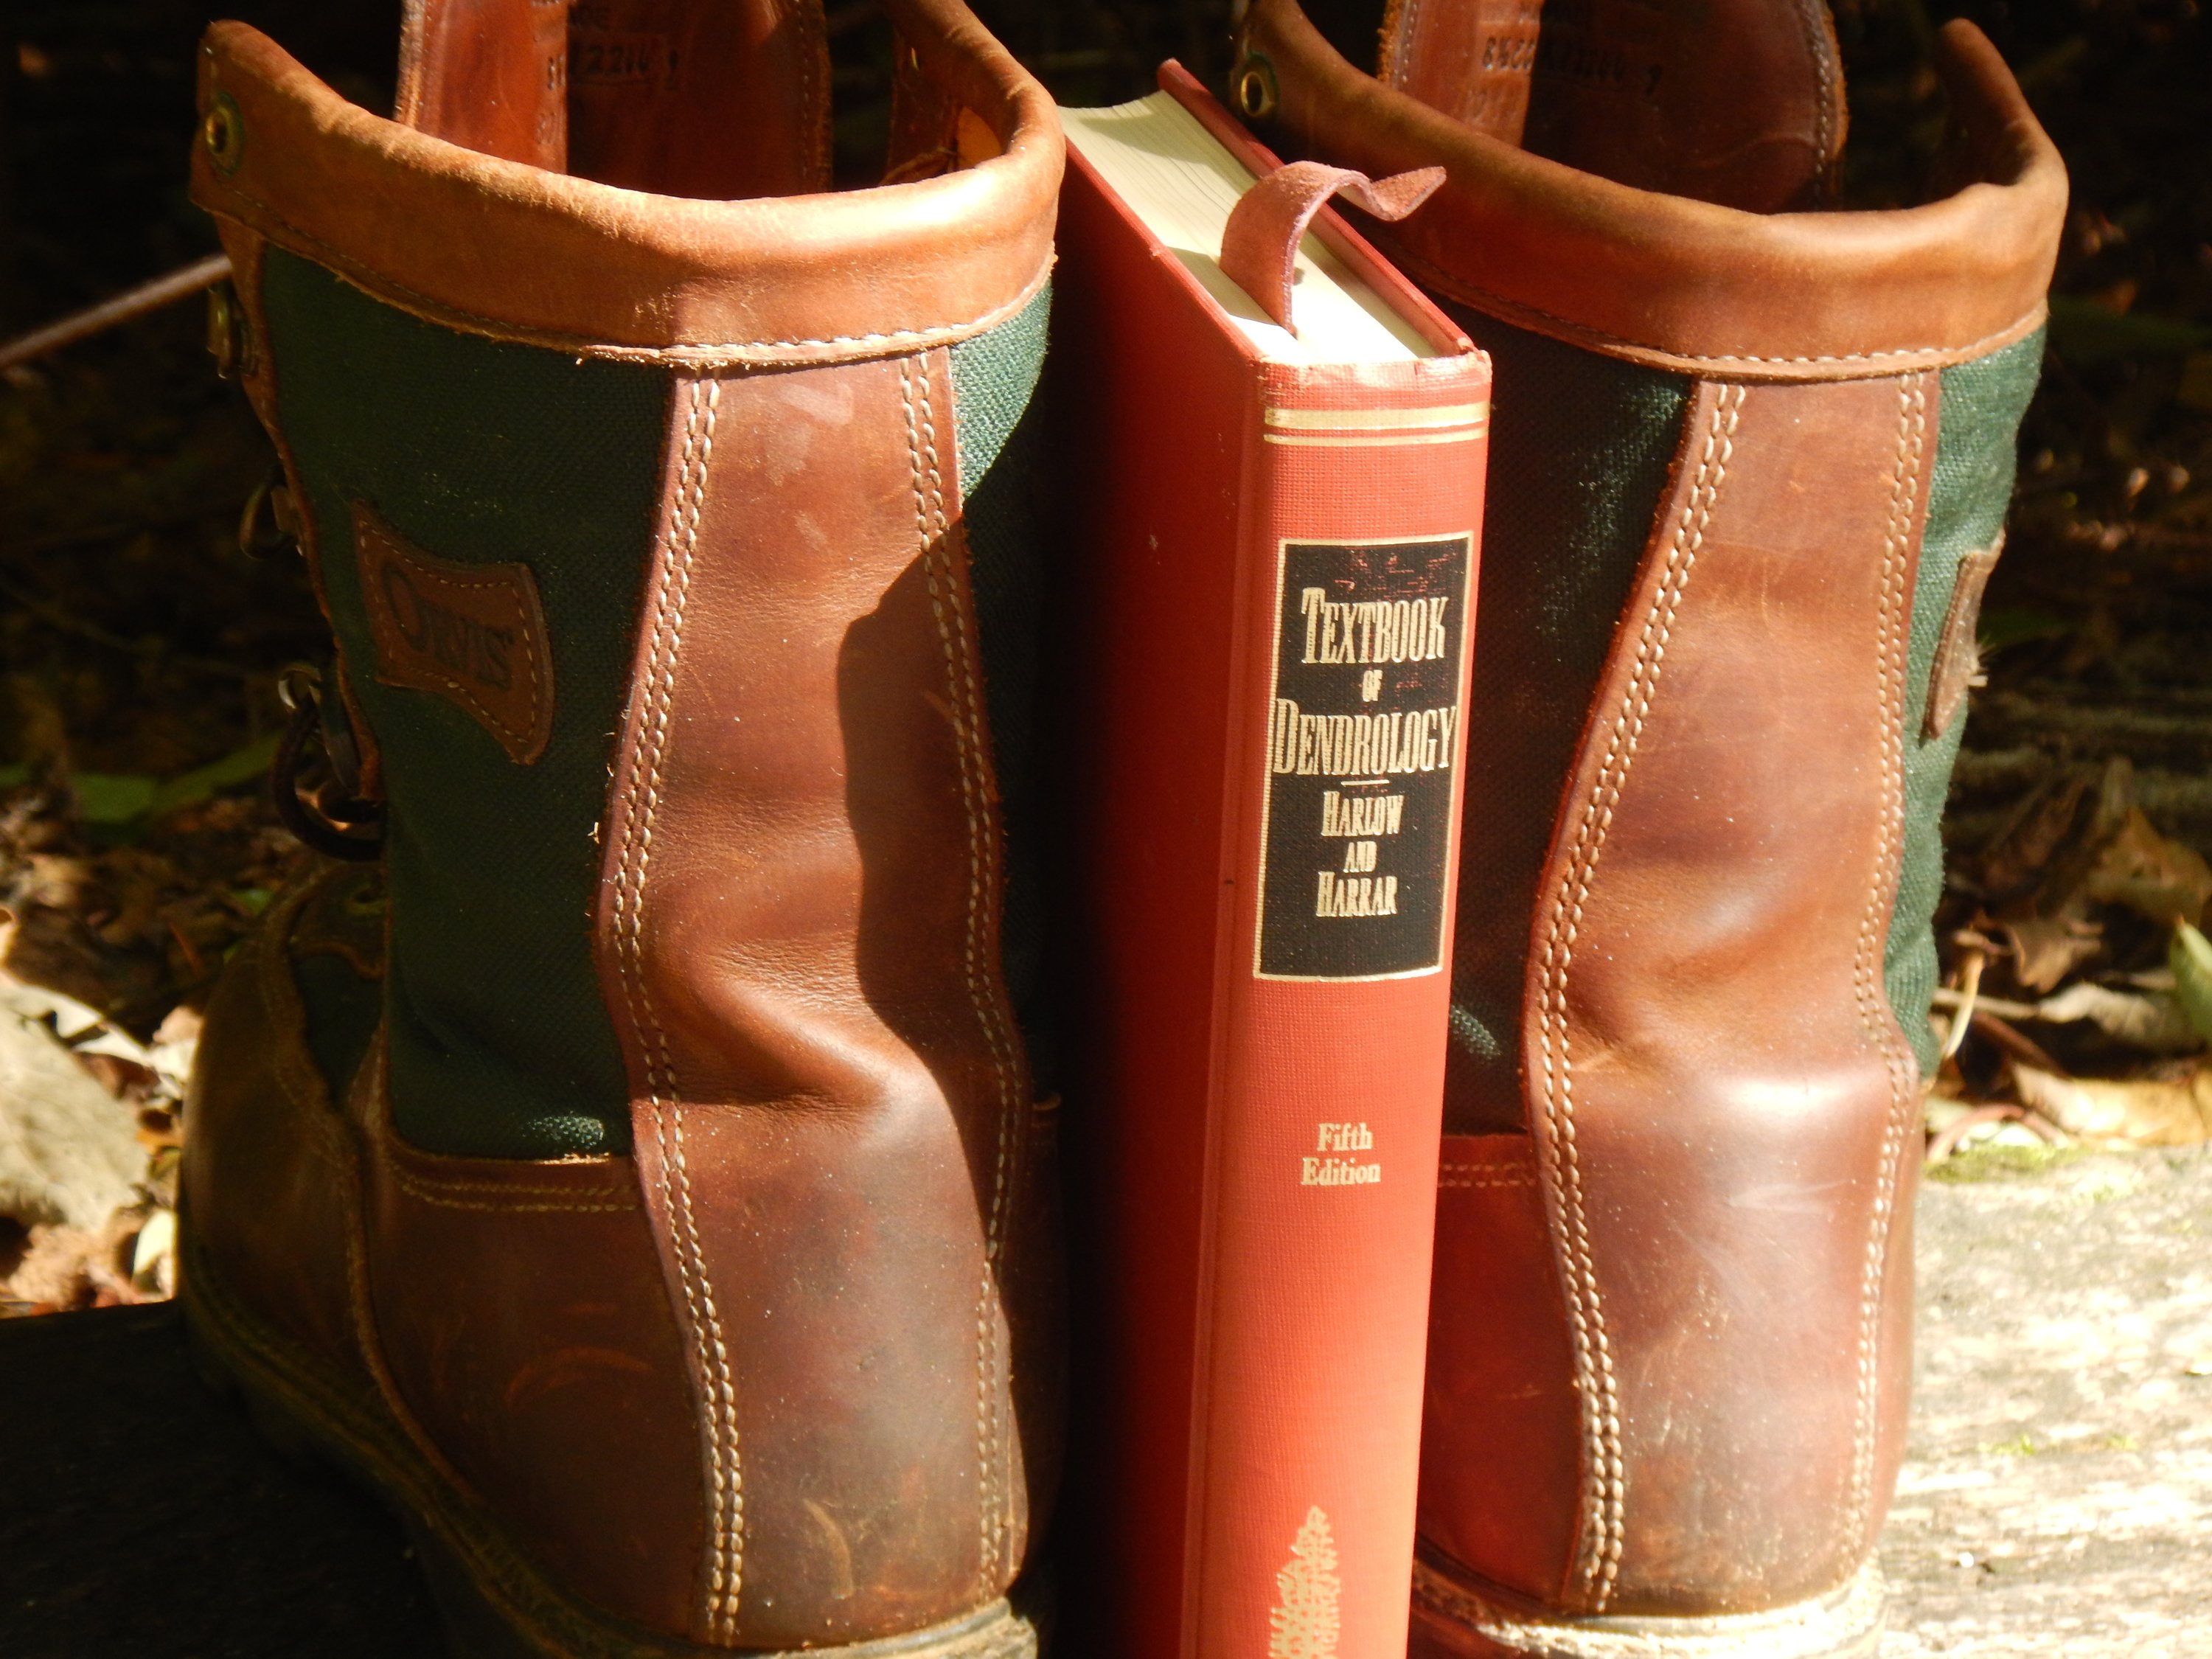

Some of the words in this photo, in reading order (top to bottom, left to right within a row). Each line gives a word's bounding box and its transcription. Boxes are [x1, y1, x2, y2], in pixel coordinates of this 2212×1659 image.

[1301, 587, 1449, 664] TEXTBOOK
[1362, 669, 1382, 702] OF
[1273, 698, 1457, 775] DENDROLOGY
[1321, 790, 1404, 836] HARLOW
[1344, 841, 1377, 873] AND
[1315, 871, 1398, 917] HARRAR
[1317, 1122, 1373, 1152] Fifth
[1301, 1157, 1381, 1186] Edition
